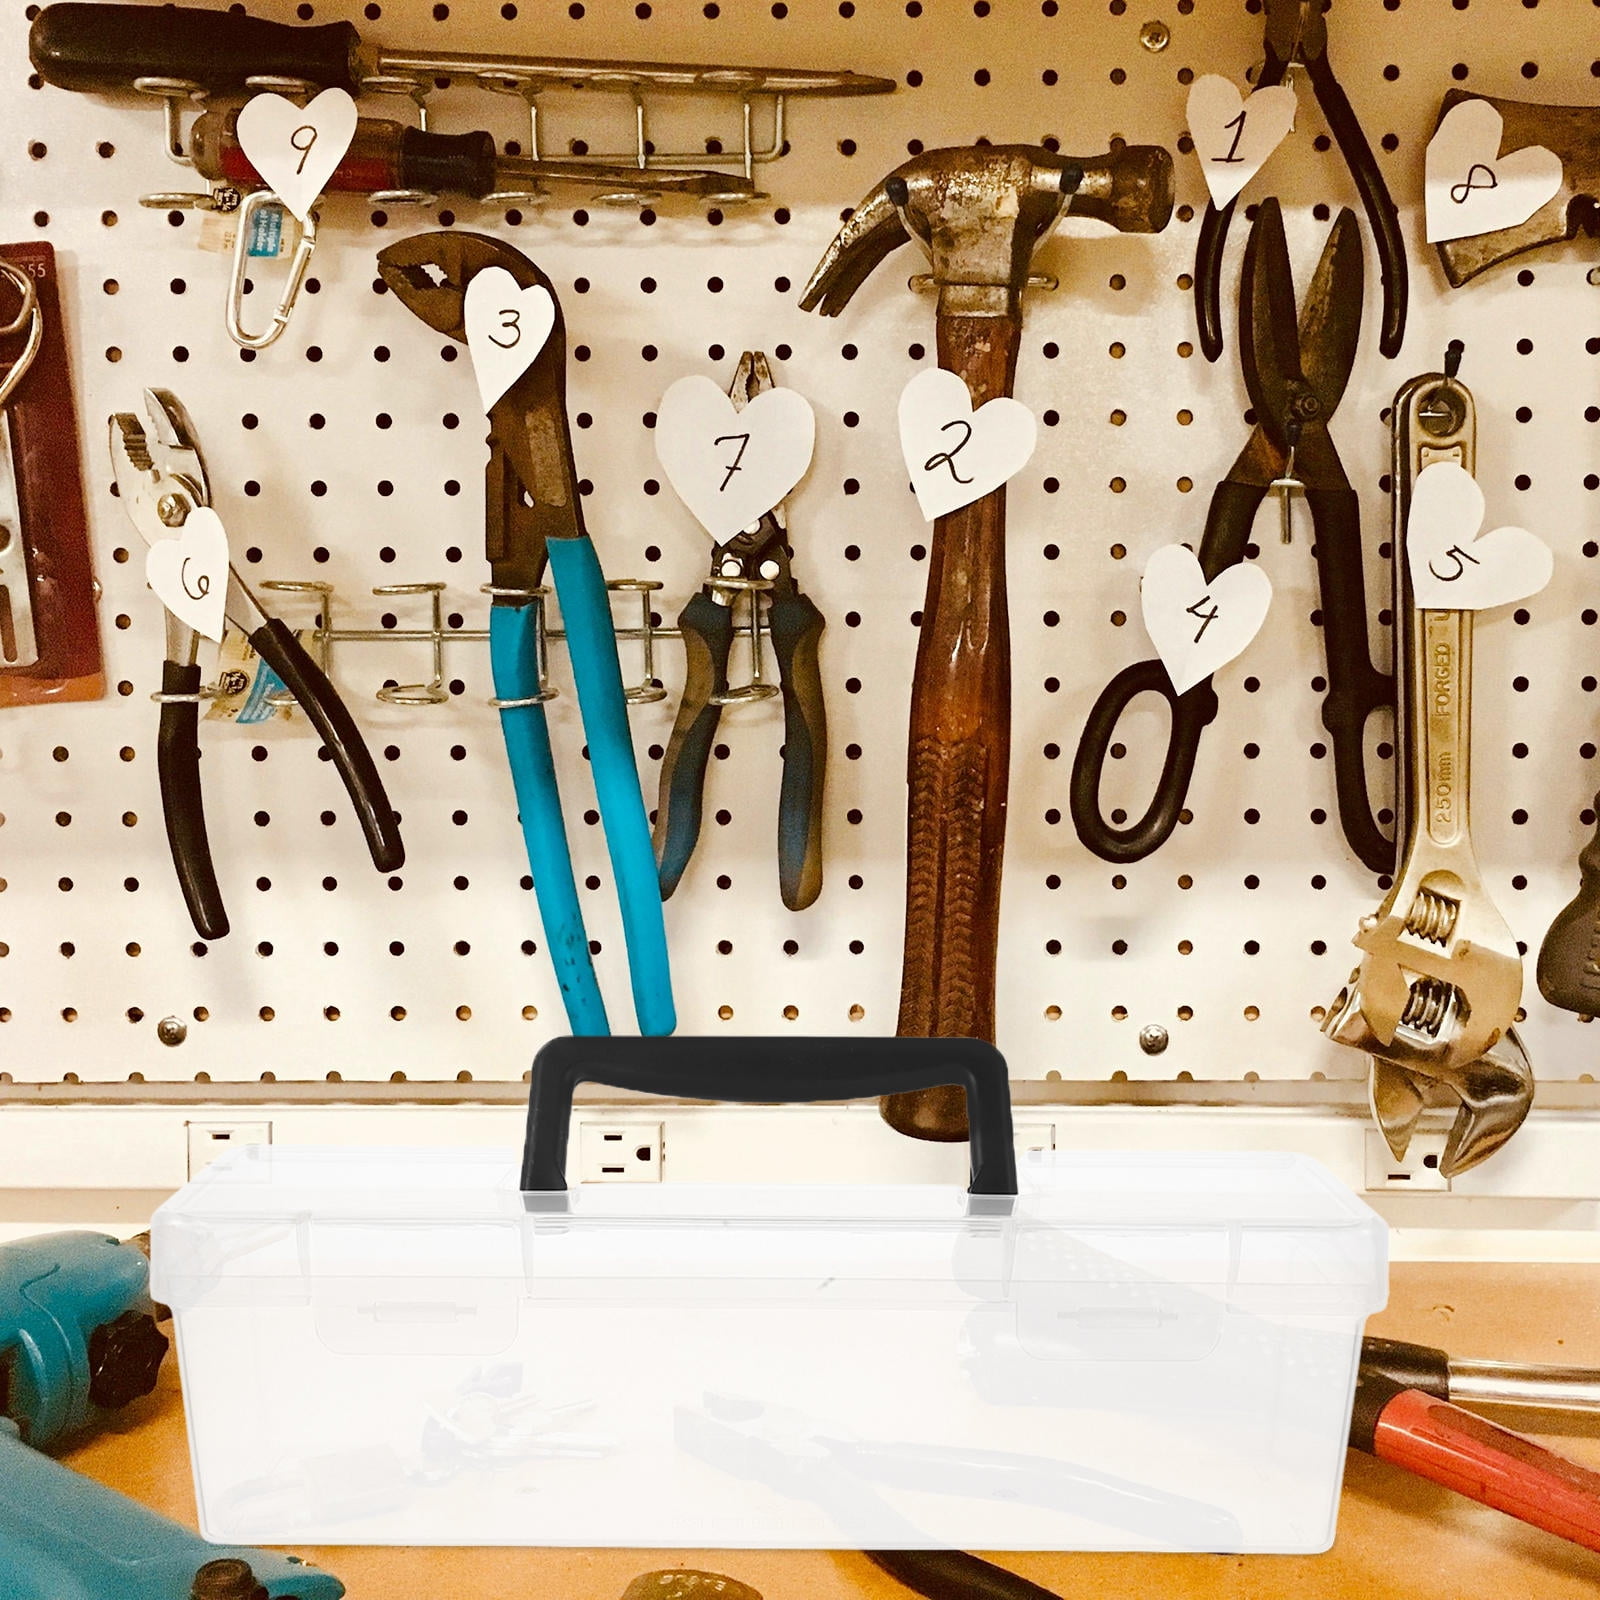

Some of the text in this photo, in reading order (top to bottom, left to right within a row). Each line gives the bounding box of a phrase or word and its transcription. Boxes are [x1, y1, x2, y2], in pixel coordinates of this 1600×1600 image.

[290, 125, 318, 175] 9
[1210, 110, 1247, 164] 1
[1450, 163, 1498, 204] 8
[487, 309, 521, 350] 3
[713, 433, 751, 492] 7
[924, 419, 974, 484] 2
[181, 557, 210, 601] 6
[1428, 544, 1481, 582] 5
[1185, 594, 1219, 644] 4
[1433, 642, 1452, 824] 250mm FORGED
